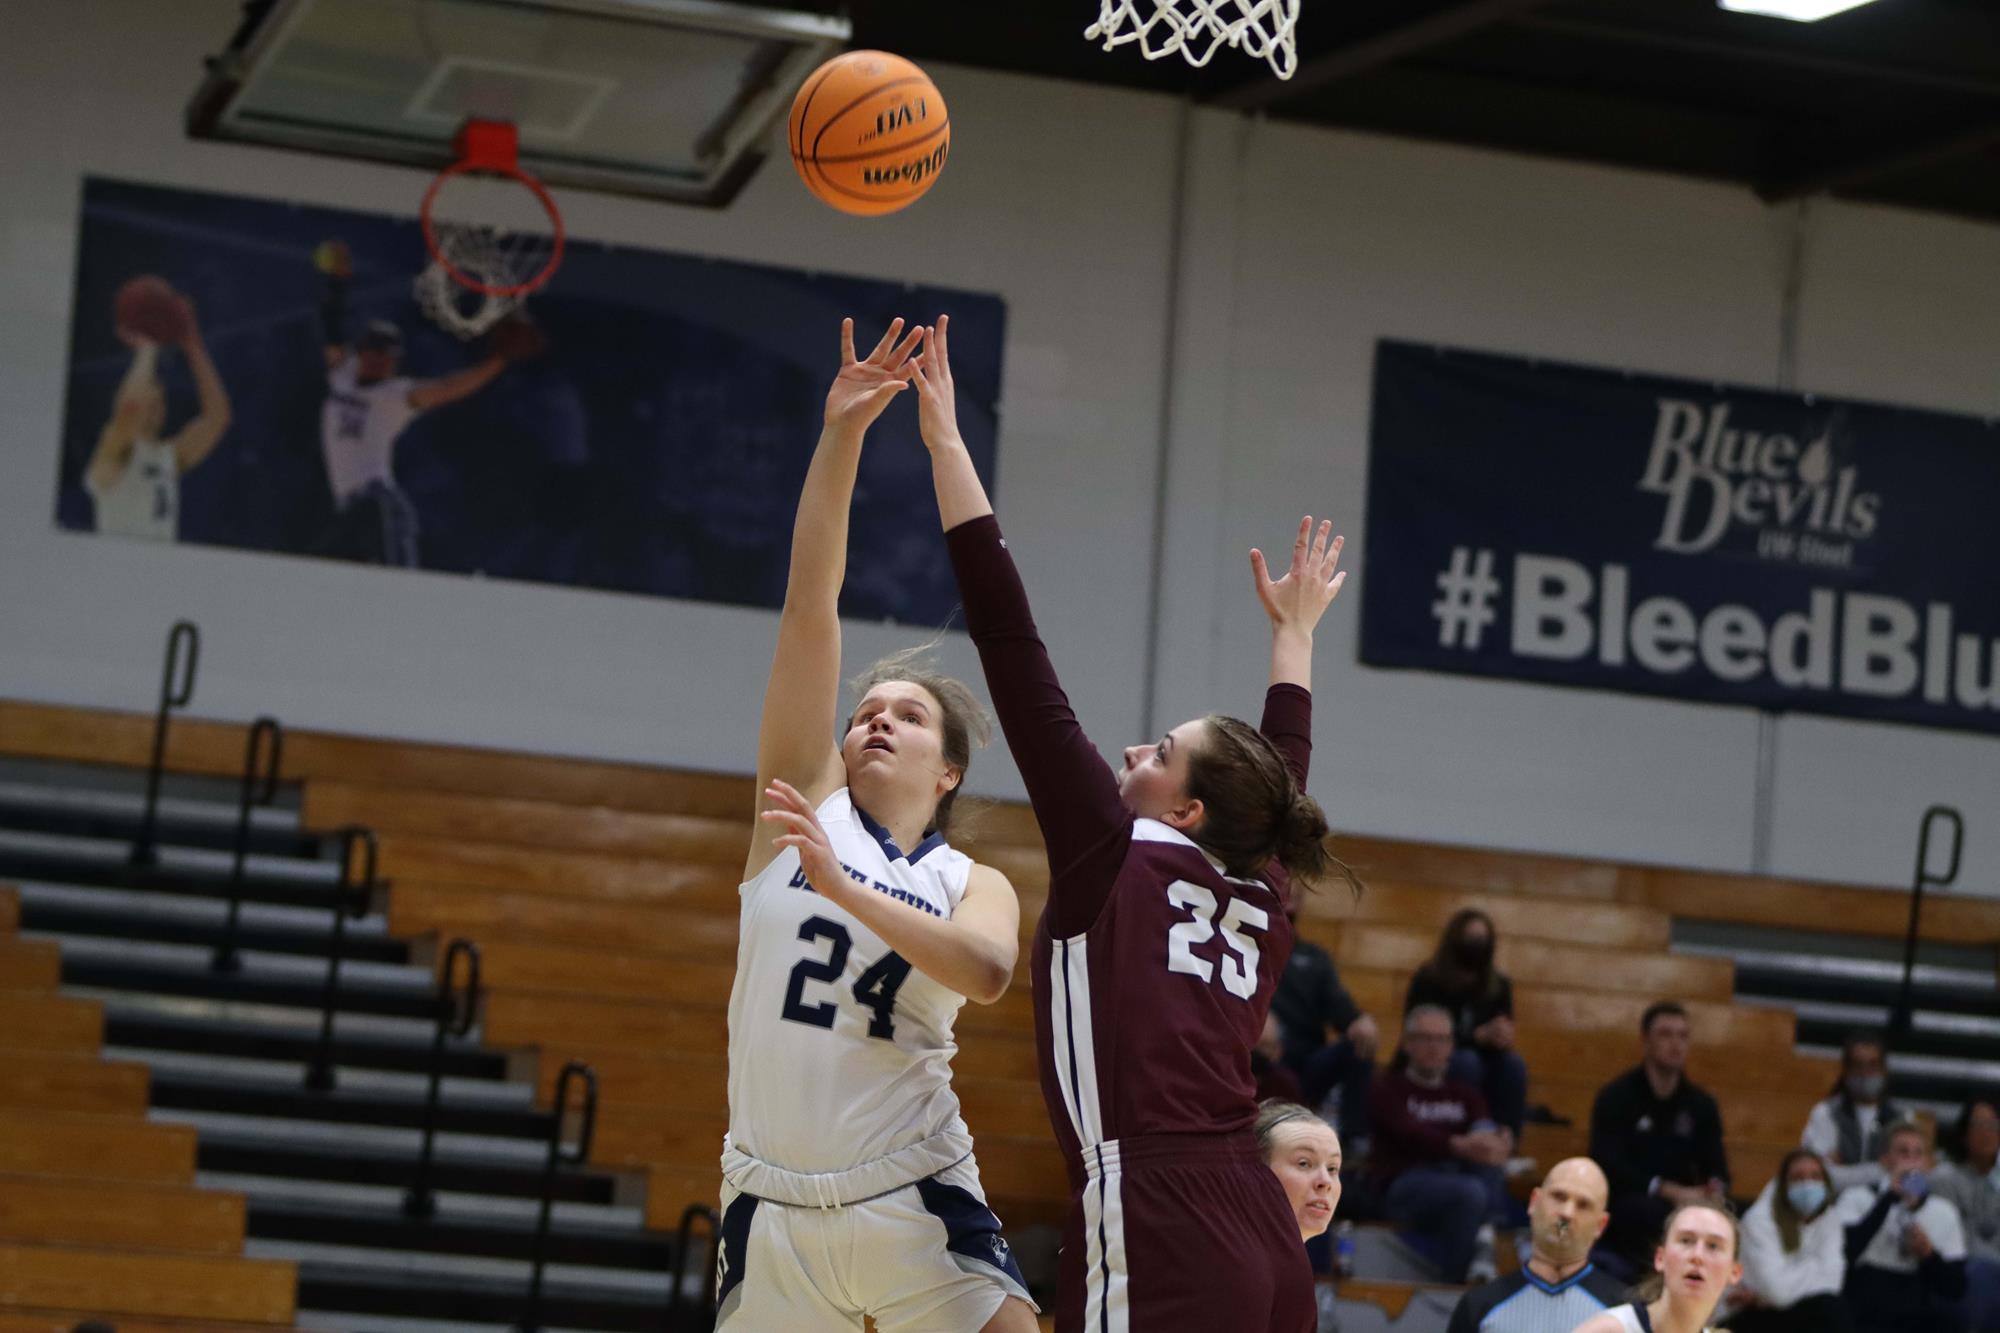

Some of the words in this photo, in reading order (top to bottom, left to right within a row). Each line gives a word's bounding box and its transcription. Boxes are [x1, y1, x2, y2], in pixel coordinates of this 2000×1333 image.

[1636, 398, 1798, 493] Blue
[1653, 465, 1881, 553] Devils
[1432, 546, 2000, 711] #BleedBlu
[780, 913, 913, 1042] 24
[1166, 879, 1269, 1000] 25
